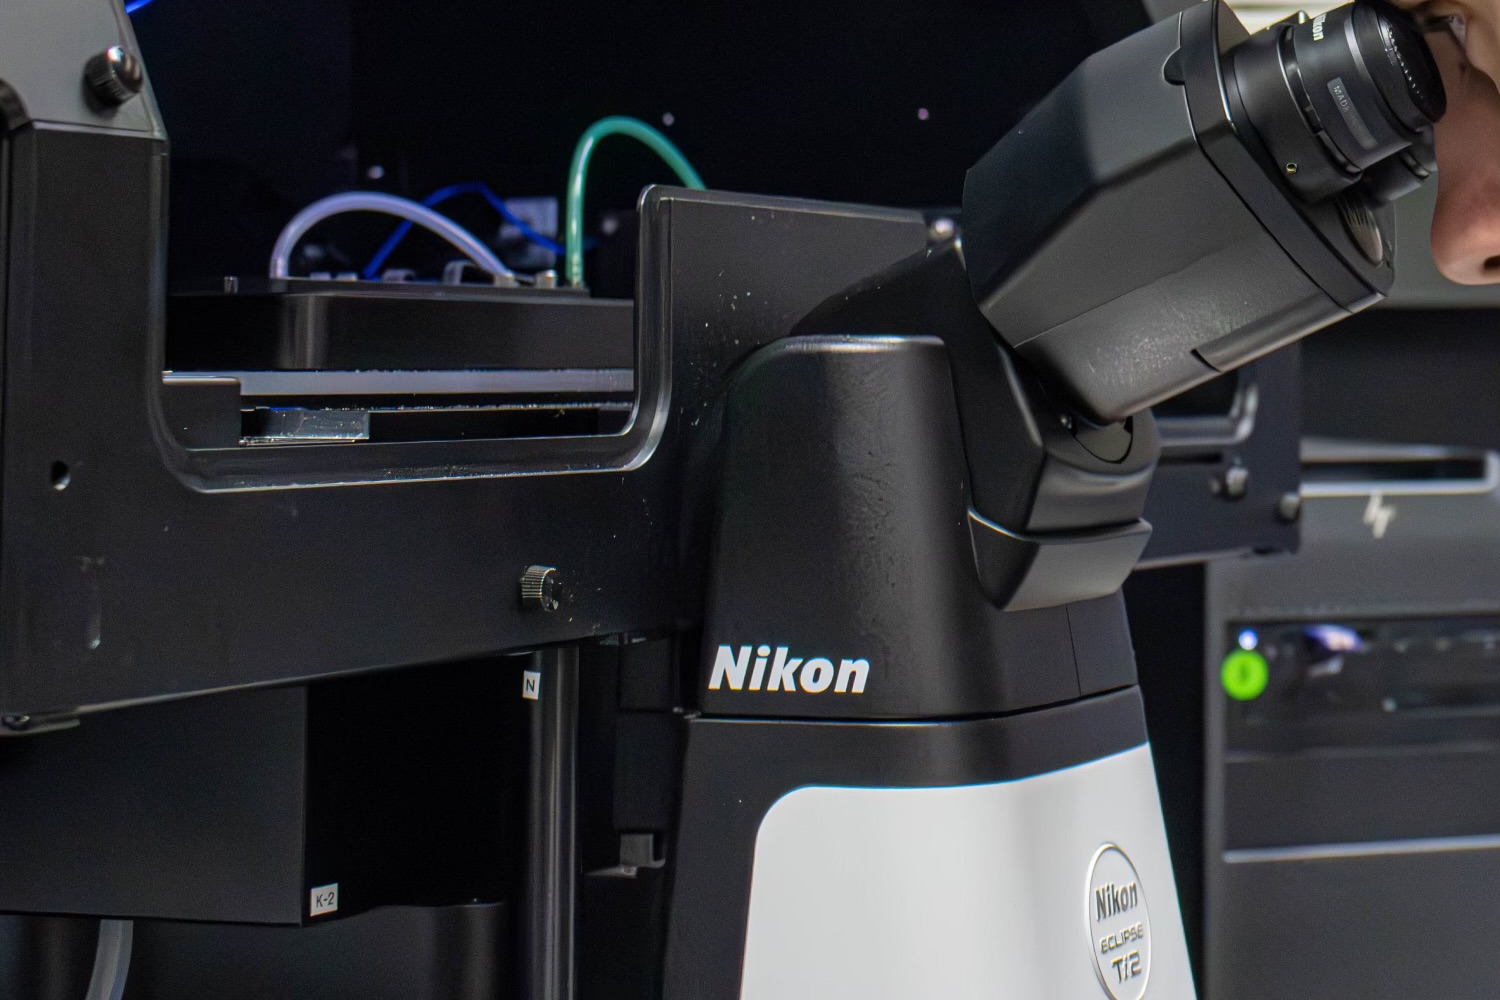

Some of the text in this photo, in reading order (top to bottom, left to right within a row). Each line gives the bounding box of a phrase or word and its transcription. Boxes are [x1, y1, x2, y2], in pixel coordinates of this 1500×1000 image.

[708, 644, 870, 693] Nikon
[526, 678, 535, 693] N
[316, 892, 335, 908] K-2
[1095, 882, 1138, 921] Nikon
[1100, 923, 1144, 954] ECLIPSE
[1111, 951, 1142, 984] Ti2
